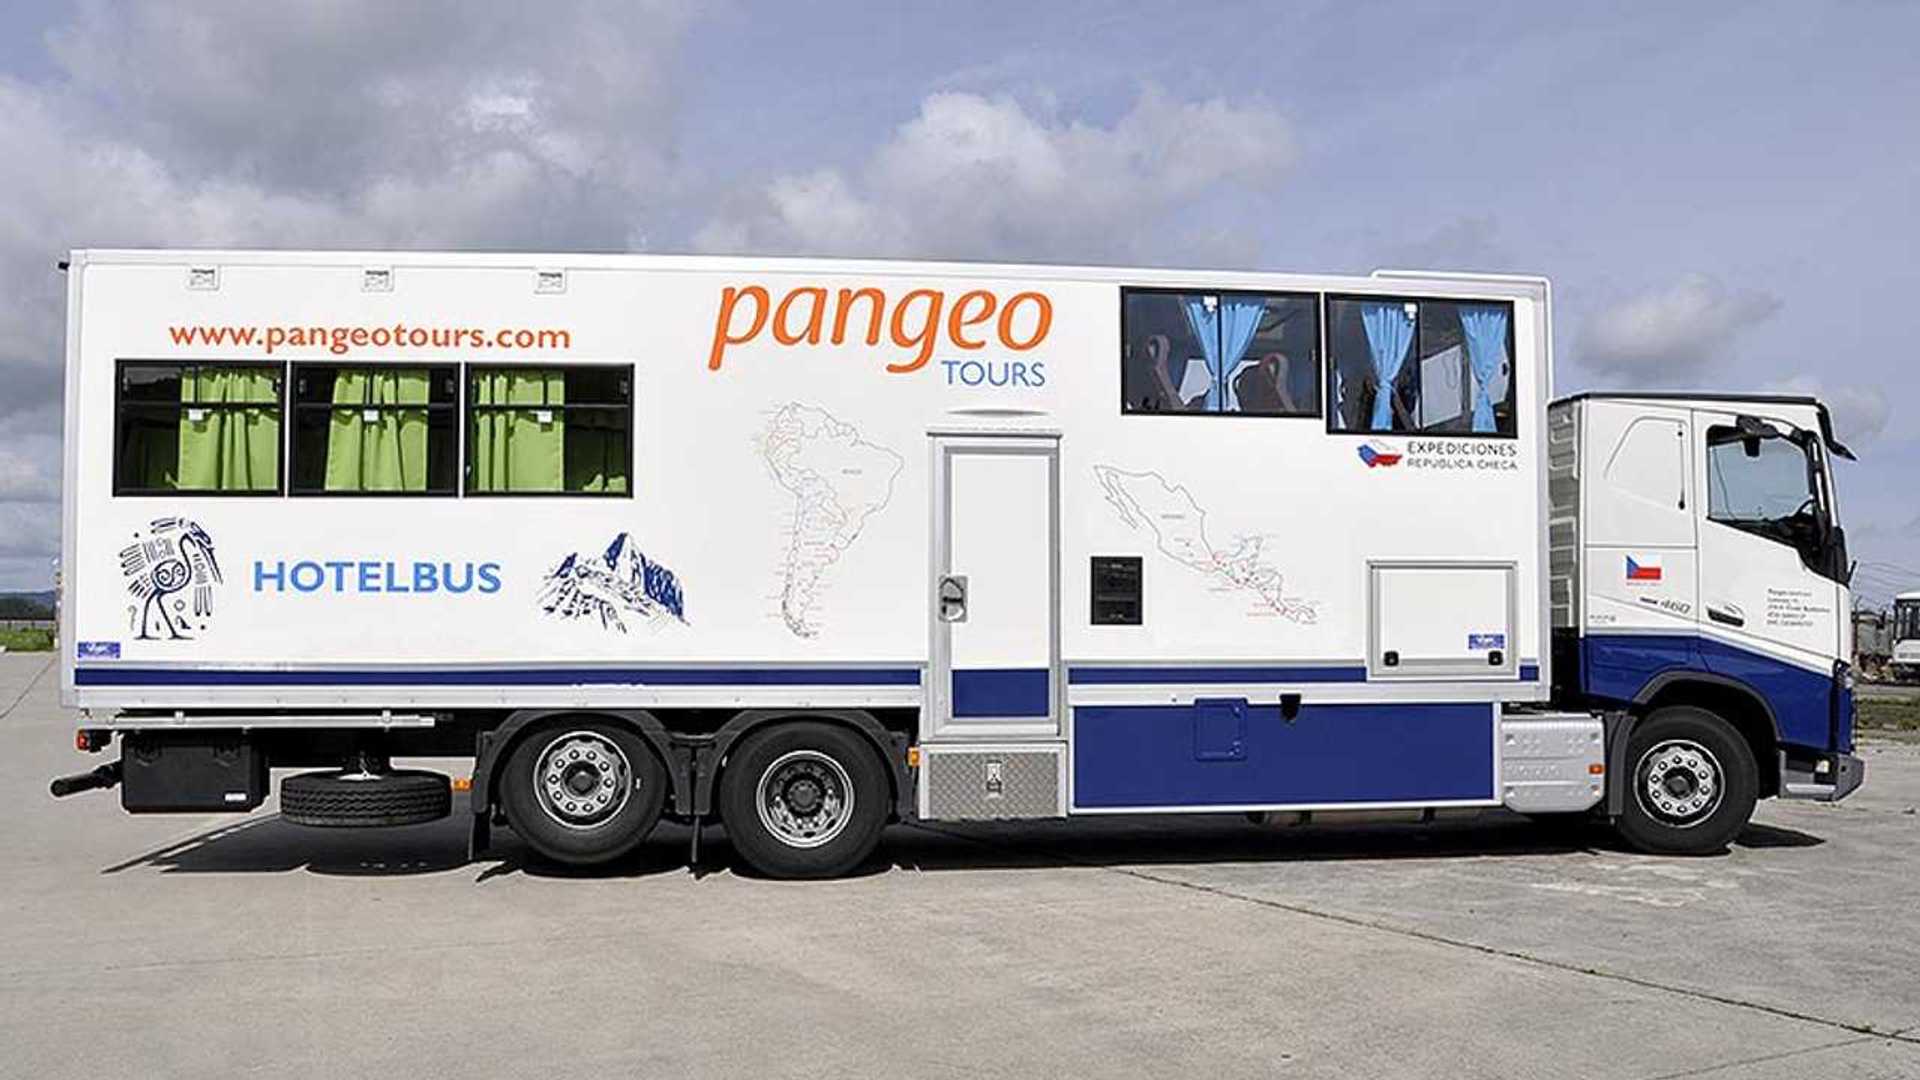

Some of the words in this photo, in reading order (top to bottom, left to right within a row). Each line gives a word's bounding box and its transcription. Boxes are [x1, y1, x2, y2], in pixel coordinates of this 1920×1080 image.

[169, 322, 572, 355] www.pangeotours.com
[707, 284, 1054, 374] pangeo
[942, 360, 1046, 387] TOURS
[1407, 441, 1517, 457] EXPEDICIONES
[1476, 459, 1518, 471] CHECA
[253, 559, 502, 596] HOTELBUS
[1660, 598, 1692, 615] 460
